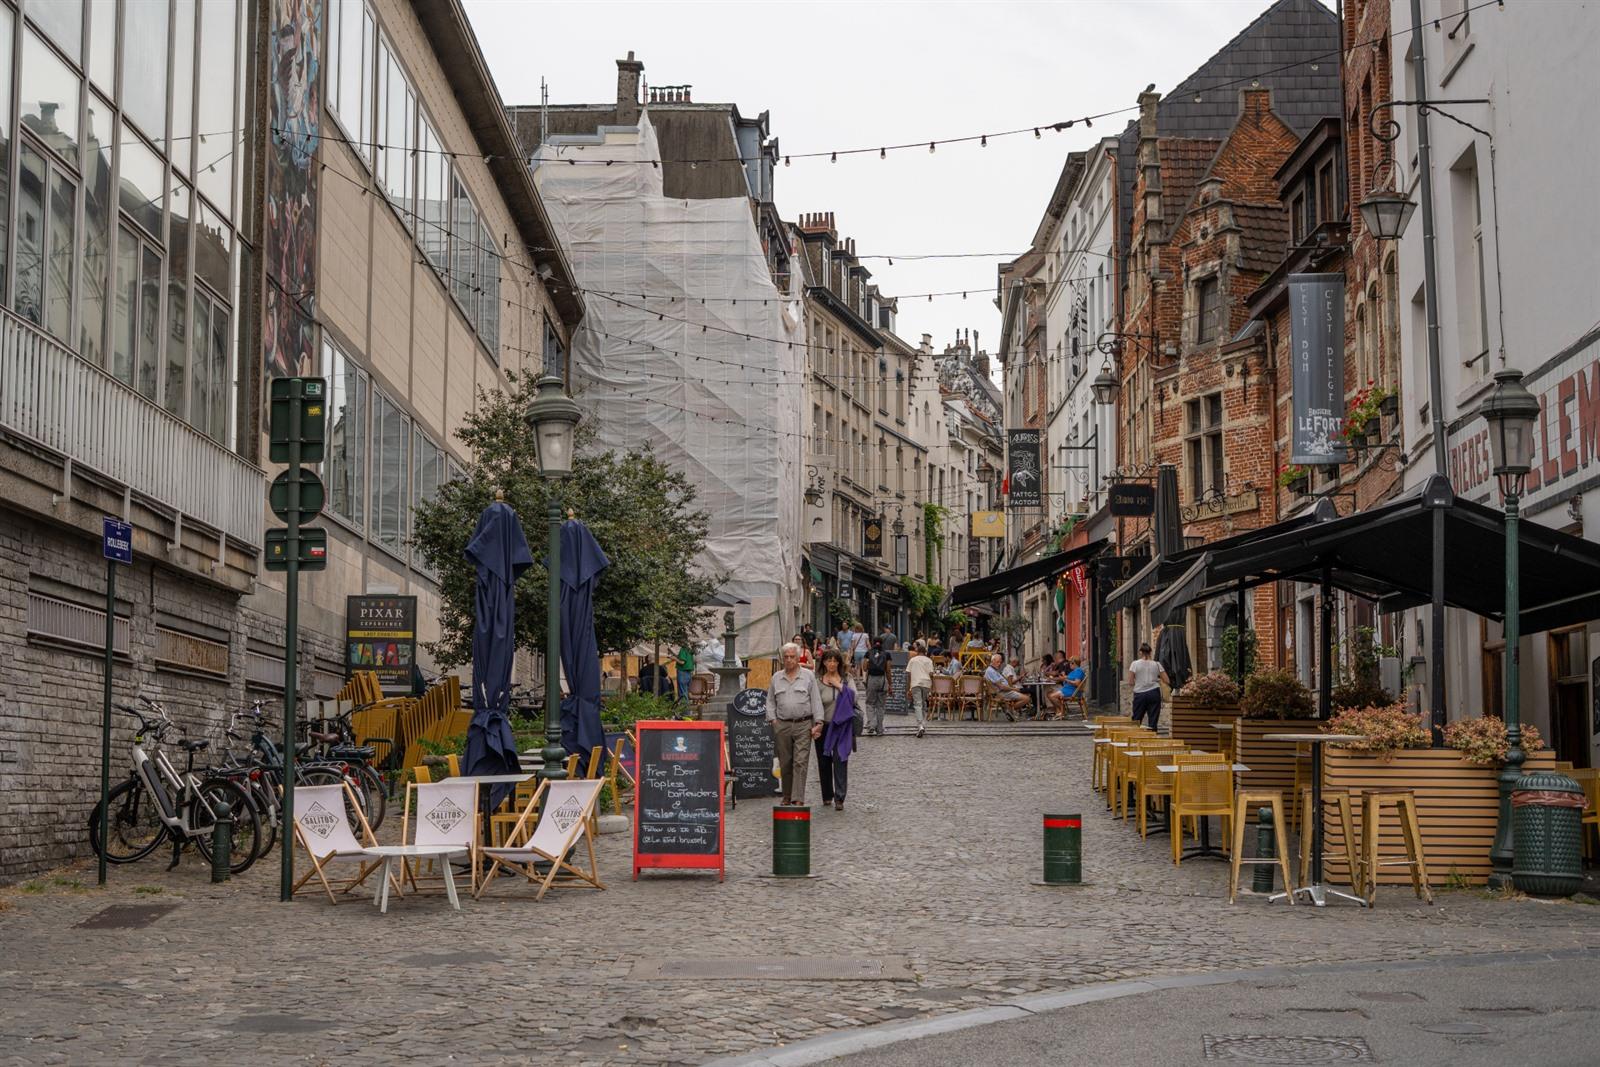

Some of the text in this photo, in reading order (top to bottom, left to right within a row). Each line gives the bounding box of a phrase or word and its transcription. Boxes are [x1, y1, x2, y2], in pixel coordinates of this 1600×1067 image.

[360, 607, 404, 619] PIXAR
[672, 764, 700, 776] Beer
[431, 810, 462, 820] SALITOS
[555, 810, 582, 818] SALITOS
[304, 815, 335, 825] SALITOS
